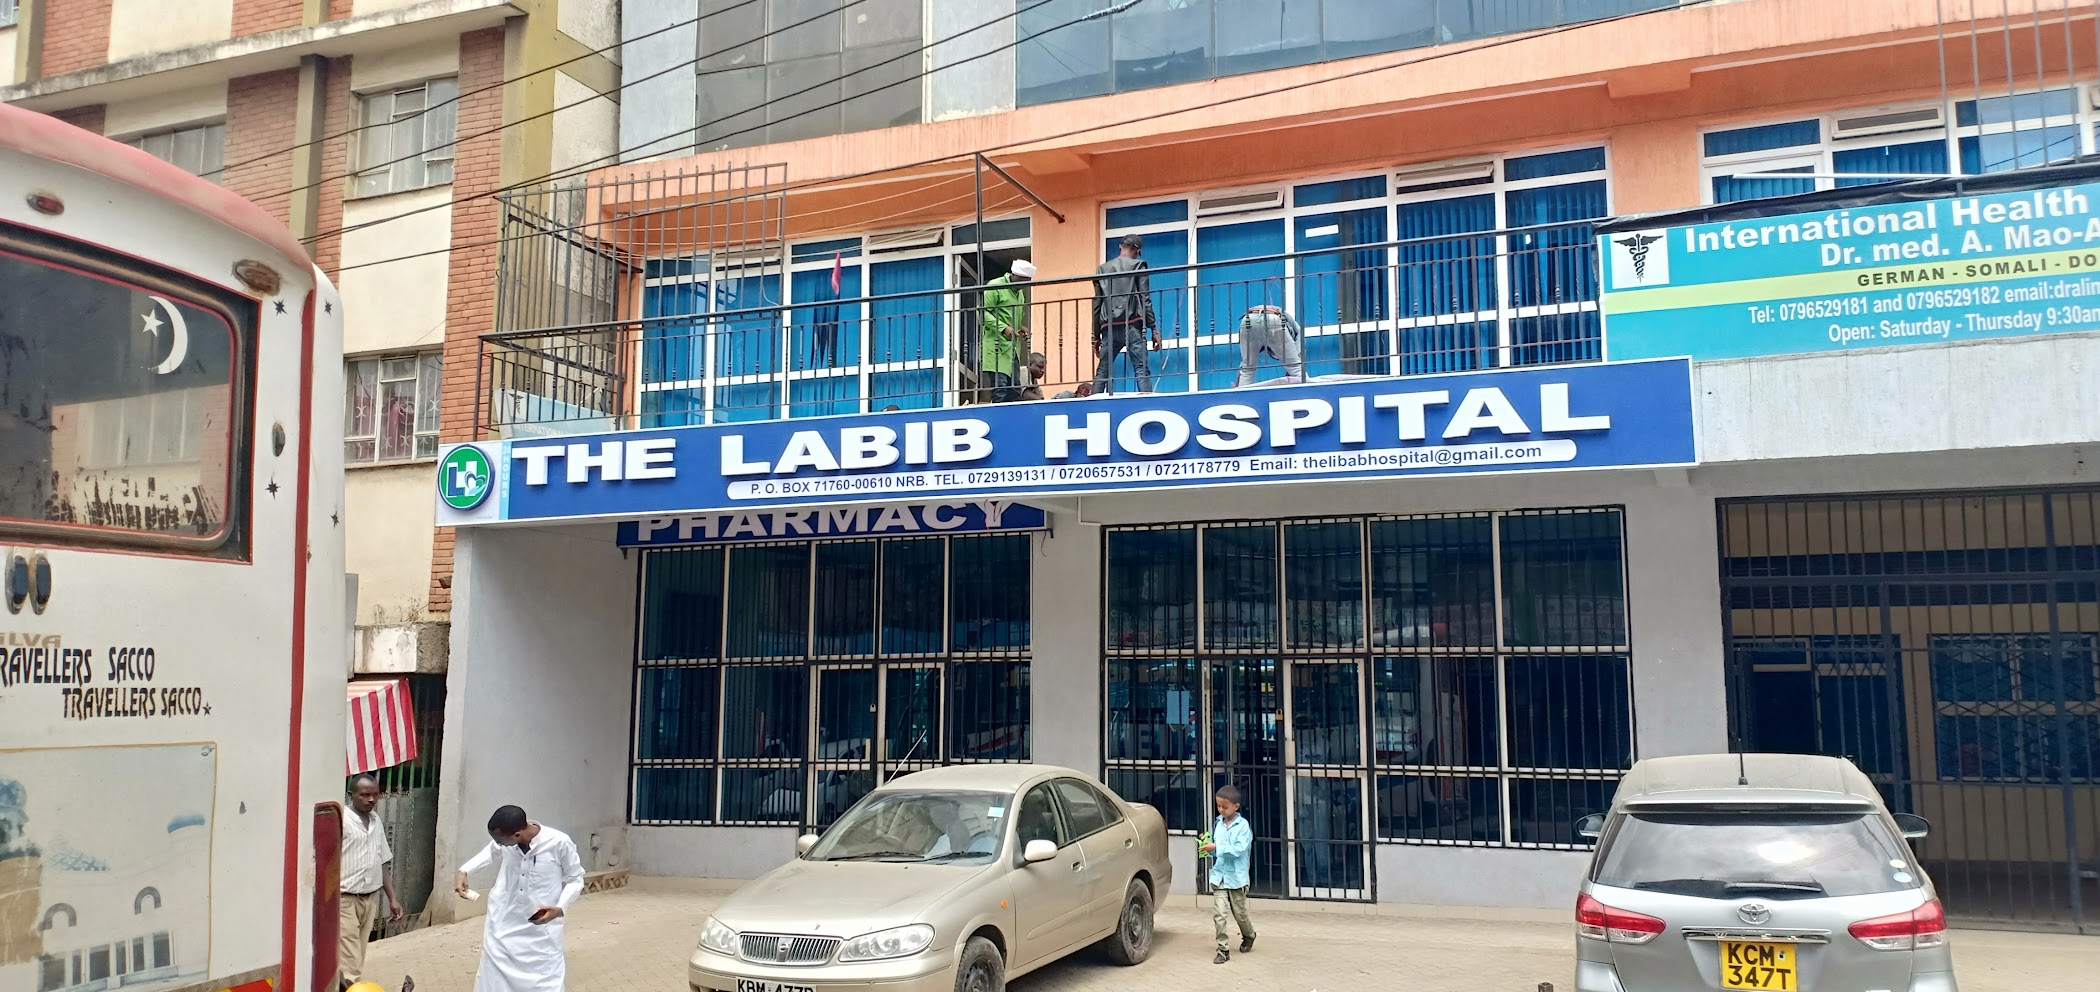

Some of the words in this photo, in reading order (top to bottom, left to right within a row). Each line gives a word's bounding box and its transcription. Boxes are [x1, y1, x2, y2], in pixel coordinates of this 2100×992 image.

[1686, 202, 1937, 252] International
[1952, 189, 2089, 226] Health
[1821, 243, 1861, 266] Dr.
[1873, 234, 1949, 262] med.
[1961, 230, 1992, 254] A.
[1858, 267, 1944, 286] GERMAN
[1966, 258, 2046, 278] SOMALI
[2069, 254, 2097, 269] DO
[1748, 306, 1775, 324] Tel:
[1780, 296, 1868, 321] 0796529181
[1873, 294, 1902, 313] and
[1907, 286, 2000, 310] 0796529182
[1828, 323, 1875, 345] Open:
[1880, 316, 1951, 338] Saturday
[1965, 309, 2042, 332] Thursday
[512, 438, 677, 486] THE
[721, 418, 993, 476] LABIB
[1044, 383, 1611, 458] HOSPITAL
[501, 454, 511, 498] HOURS
[751, 484, 761, 494] P.
[765, 483, 778, 494] O.
[782, 481, 810, 493] BOX
[814, 477, 892, 491] 71760-00610
[896, 475, 928, 488] NRB.
[934, 473, 963, 486] TEL.
[968, 469, 1046, 484] 0729139131
[1059, 465, 1141, 480] 0720657531
[1155, 460, 1240, 476] 0721178779
[1250, 457, 1298, 471] Email:
[1303, 446, 1542, 468] thelibabhospital@gmail.com
[637, 500, 1014, 541] PHARMACY
[108, 646, 155, 684] SACCO
[62, 687, 156, 721] TRAVELLERS
[161, 687, 201, 718] SACCO
[1728, 943, 1775, 966] KCM
[738, 979, 765, 992] KBM
[1728, 965, 1791, 990] 347T
